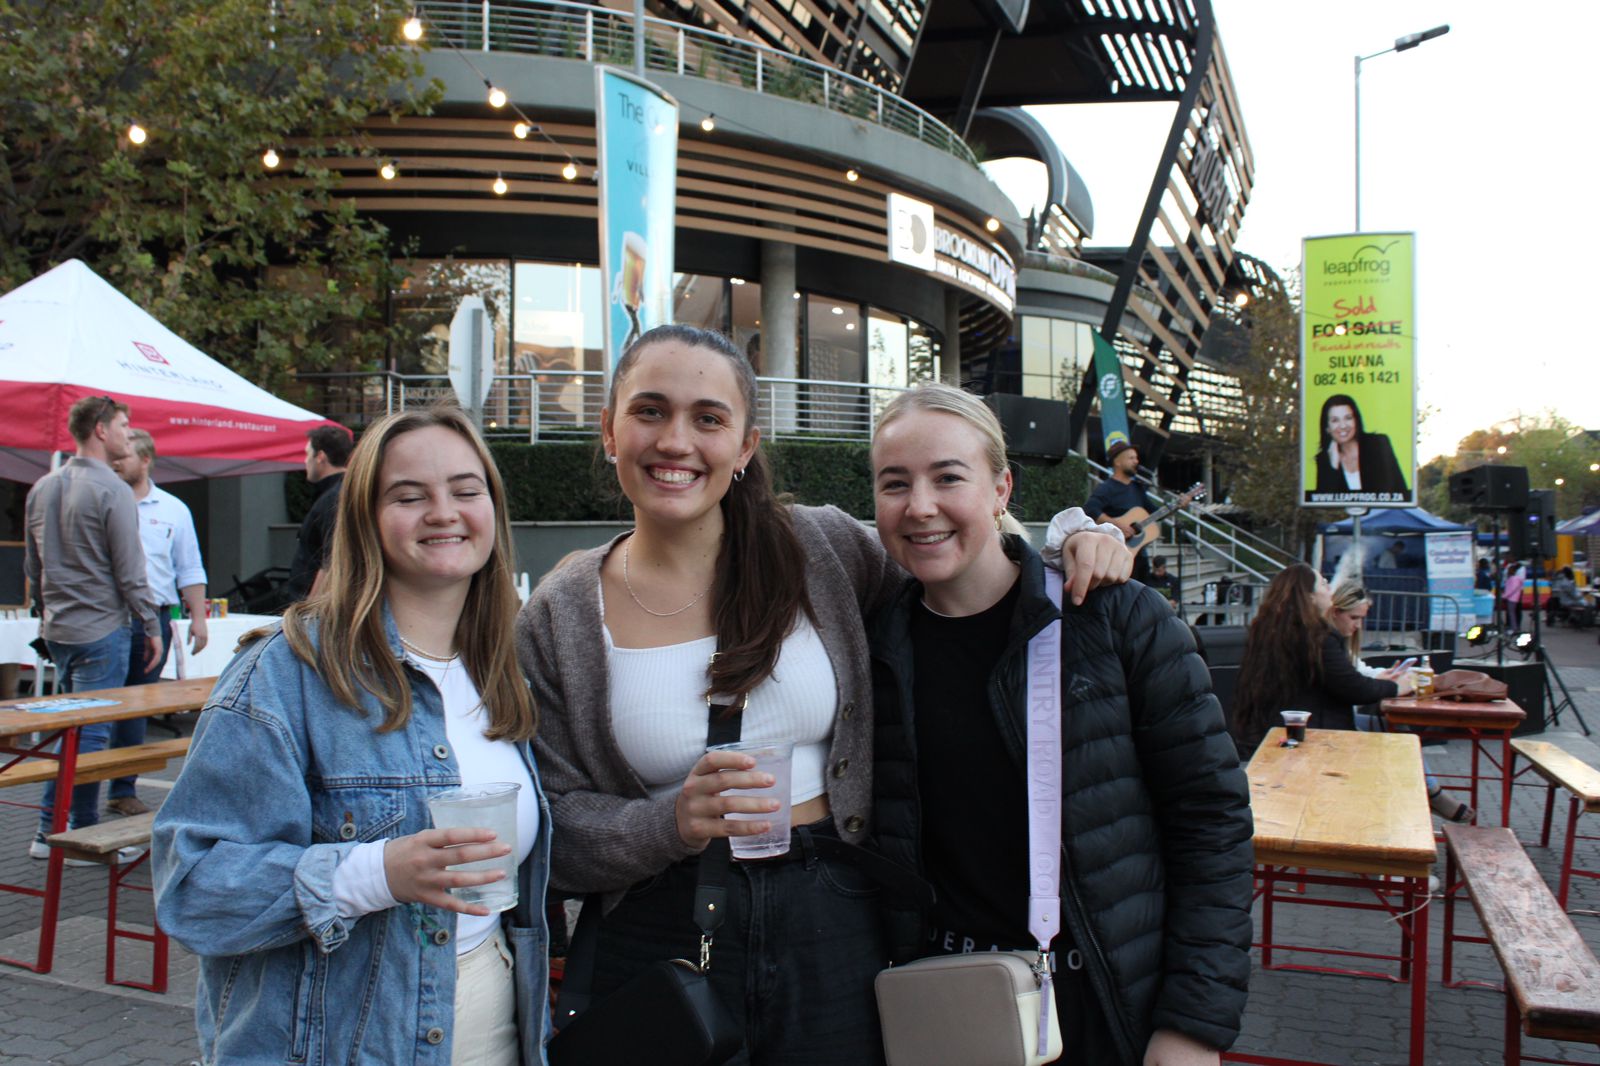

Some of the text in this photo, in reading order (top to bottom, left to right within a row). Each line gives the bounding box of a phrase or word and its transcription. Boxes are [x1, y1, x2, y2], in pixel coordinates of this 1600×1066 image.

[618, 92, 644, 124] The
[1323, 257, 1391, 276] leapfrog
[1352, 320, 1402, 336] SALE
[1329, 354, 1384, 369] SILVANA
[1313, 370, 1400, 386] 082 416 1421
[169, 417, 277, 432] www.hinterland.restaurant
[1032, 624, 1056, 732] OUNTRY
